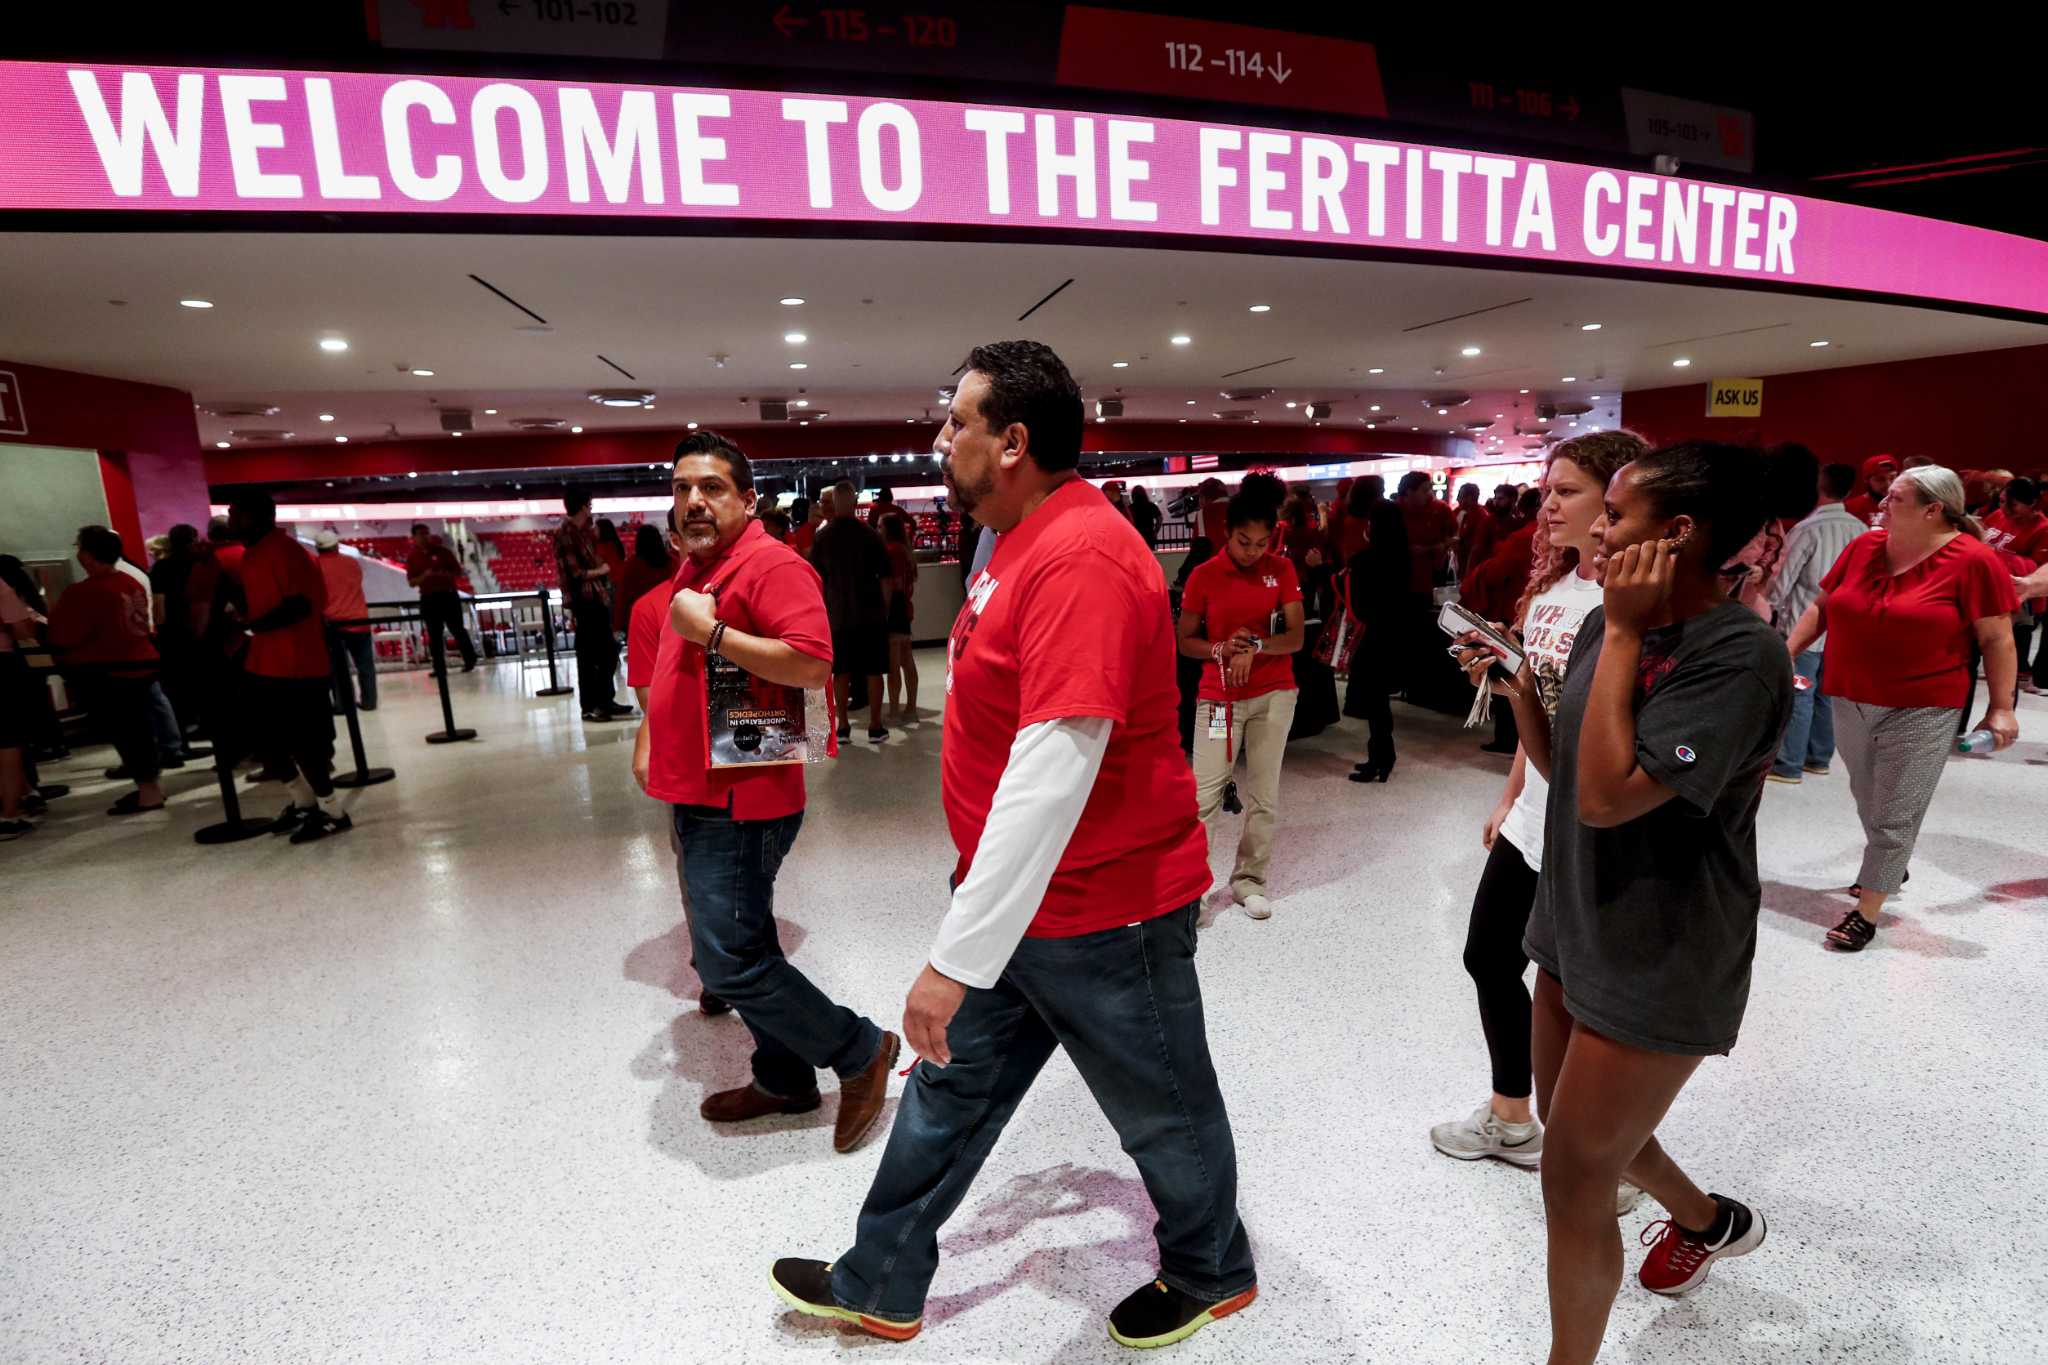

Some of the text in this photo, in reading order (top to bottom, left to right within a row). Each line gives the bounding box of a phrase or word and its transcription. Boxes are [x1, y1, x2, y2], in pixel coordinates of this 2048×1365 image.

[67, 69, 1798, 275] WELCOME TO THE FERTITTA CENTER
[1715, 389, 1759, 406] ASK US
